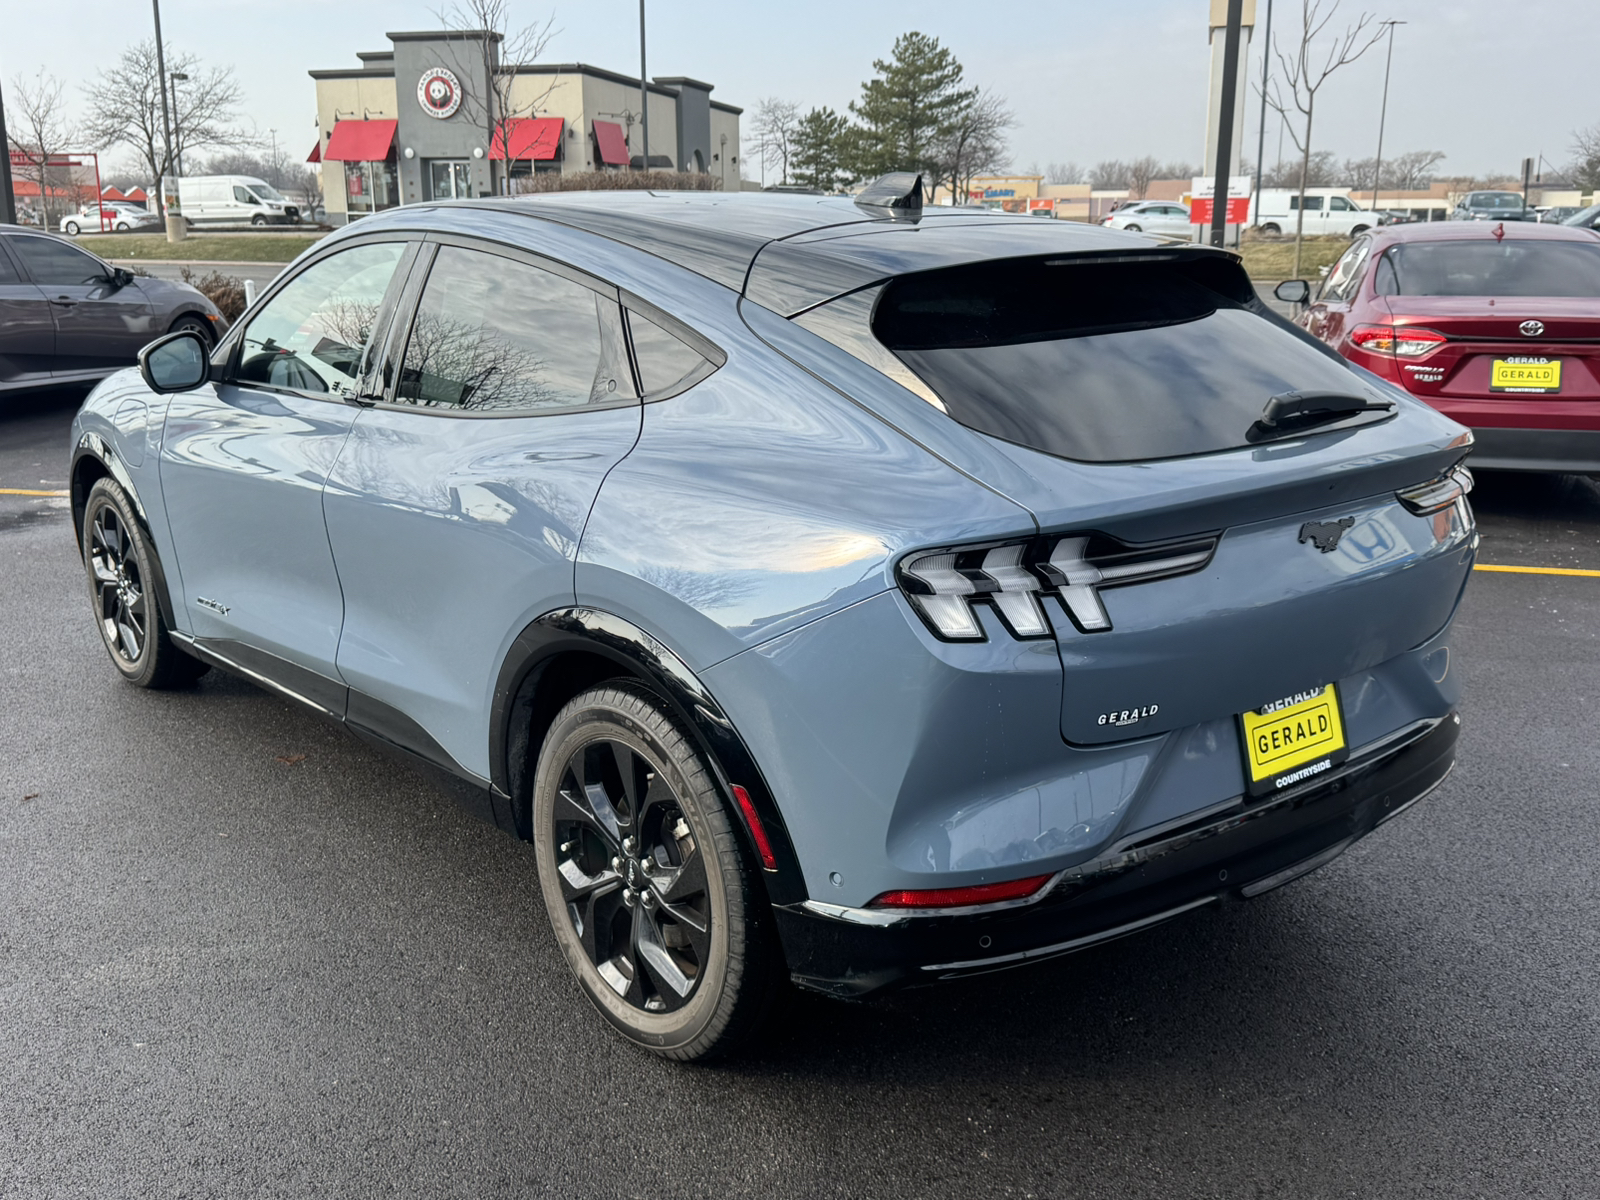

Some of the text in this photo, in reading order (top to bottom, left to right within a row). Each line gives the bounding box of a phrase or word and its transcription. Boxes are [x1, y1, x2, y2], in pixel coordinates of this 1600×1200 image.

[1414, 373, 1443, 381] GERALD
[1501, 370, 1550, 379] GERALD
[1097, 704, 1159, 725] GERALD
[1258, 714, 1328, 754] GERALD
[1275, 759, 1331, 788] COUNTRYSIDE
